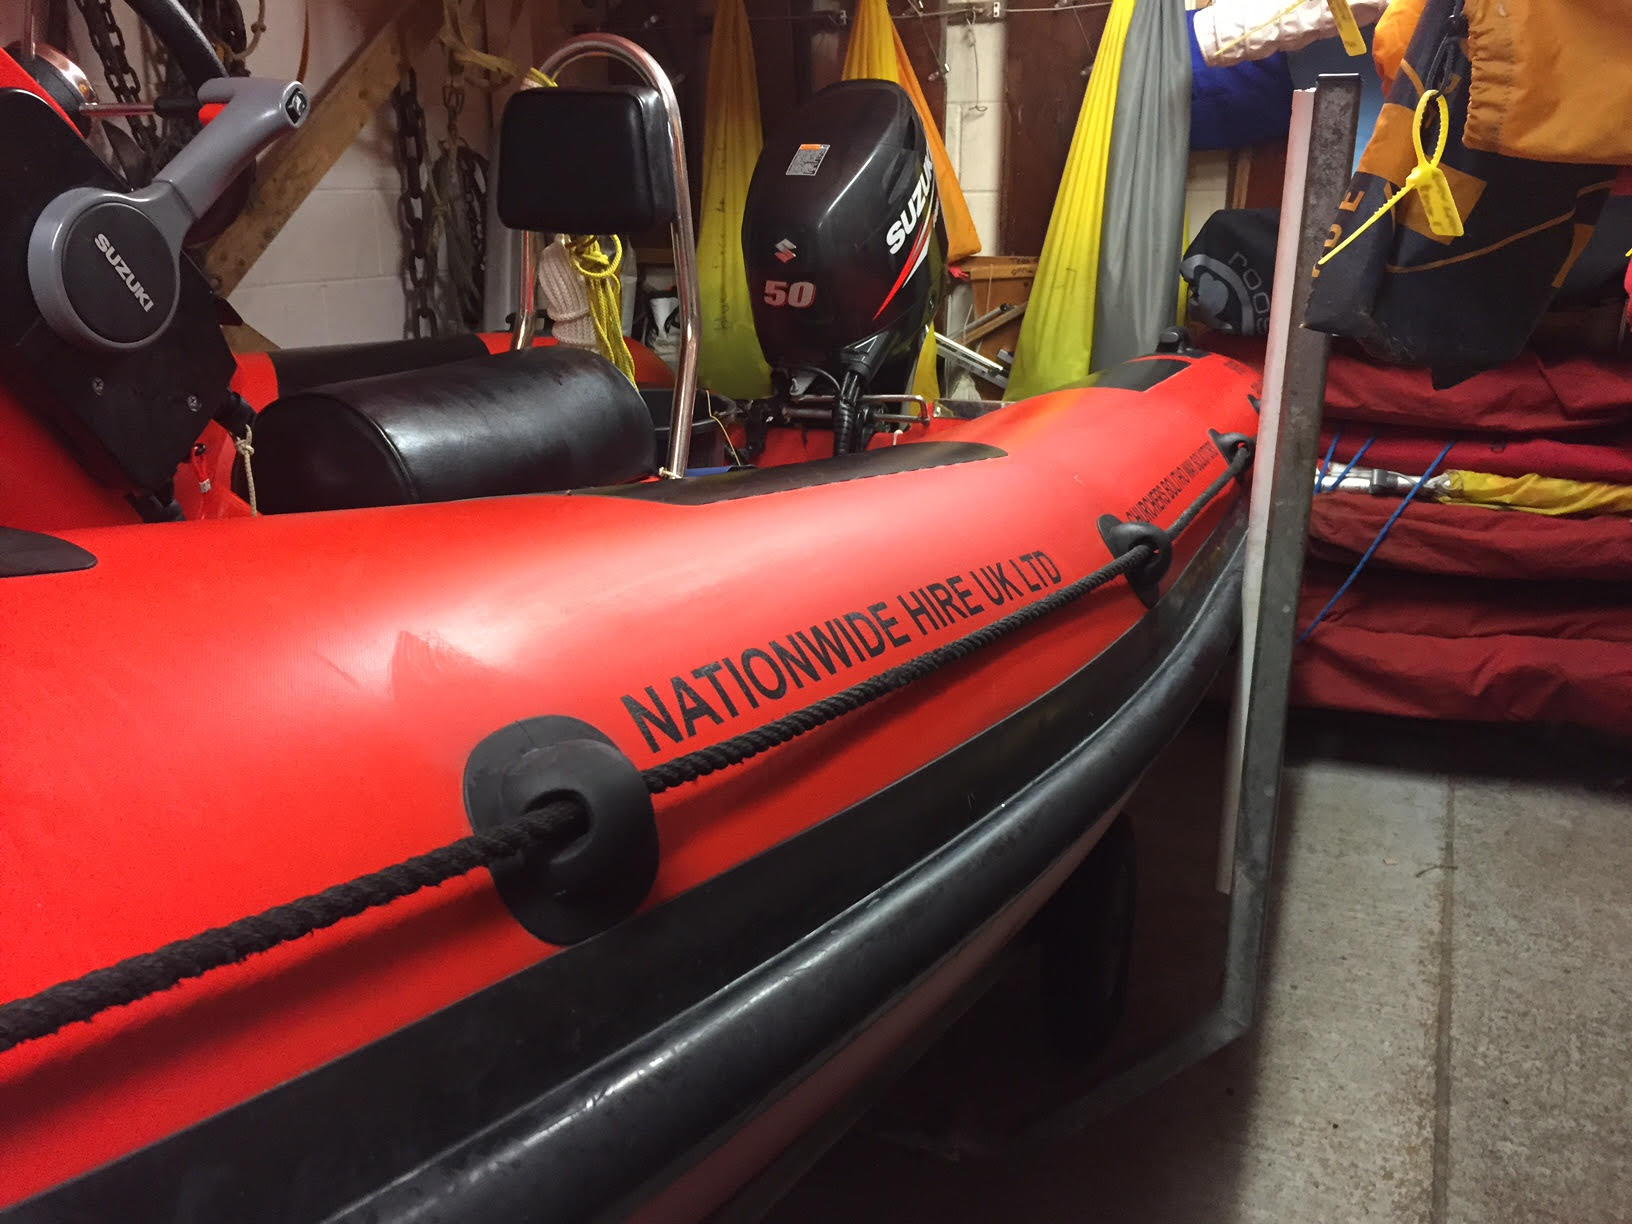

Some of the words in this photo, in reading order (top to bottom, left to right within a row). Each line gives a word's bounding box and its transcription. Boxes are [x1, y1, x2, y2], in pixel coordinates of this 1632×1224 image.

[95, 233, 154, 312] SUZUKI
[764, 280, 816, 308] 50
[620, 602, 910, 753] NATIONWIDE
[896, 574, 985, 637] HIRE
[969, 562, 1024, 606] UK
[1008, 550, 1063, 593] LTD
